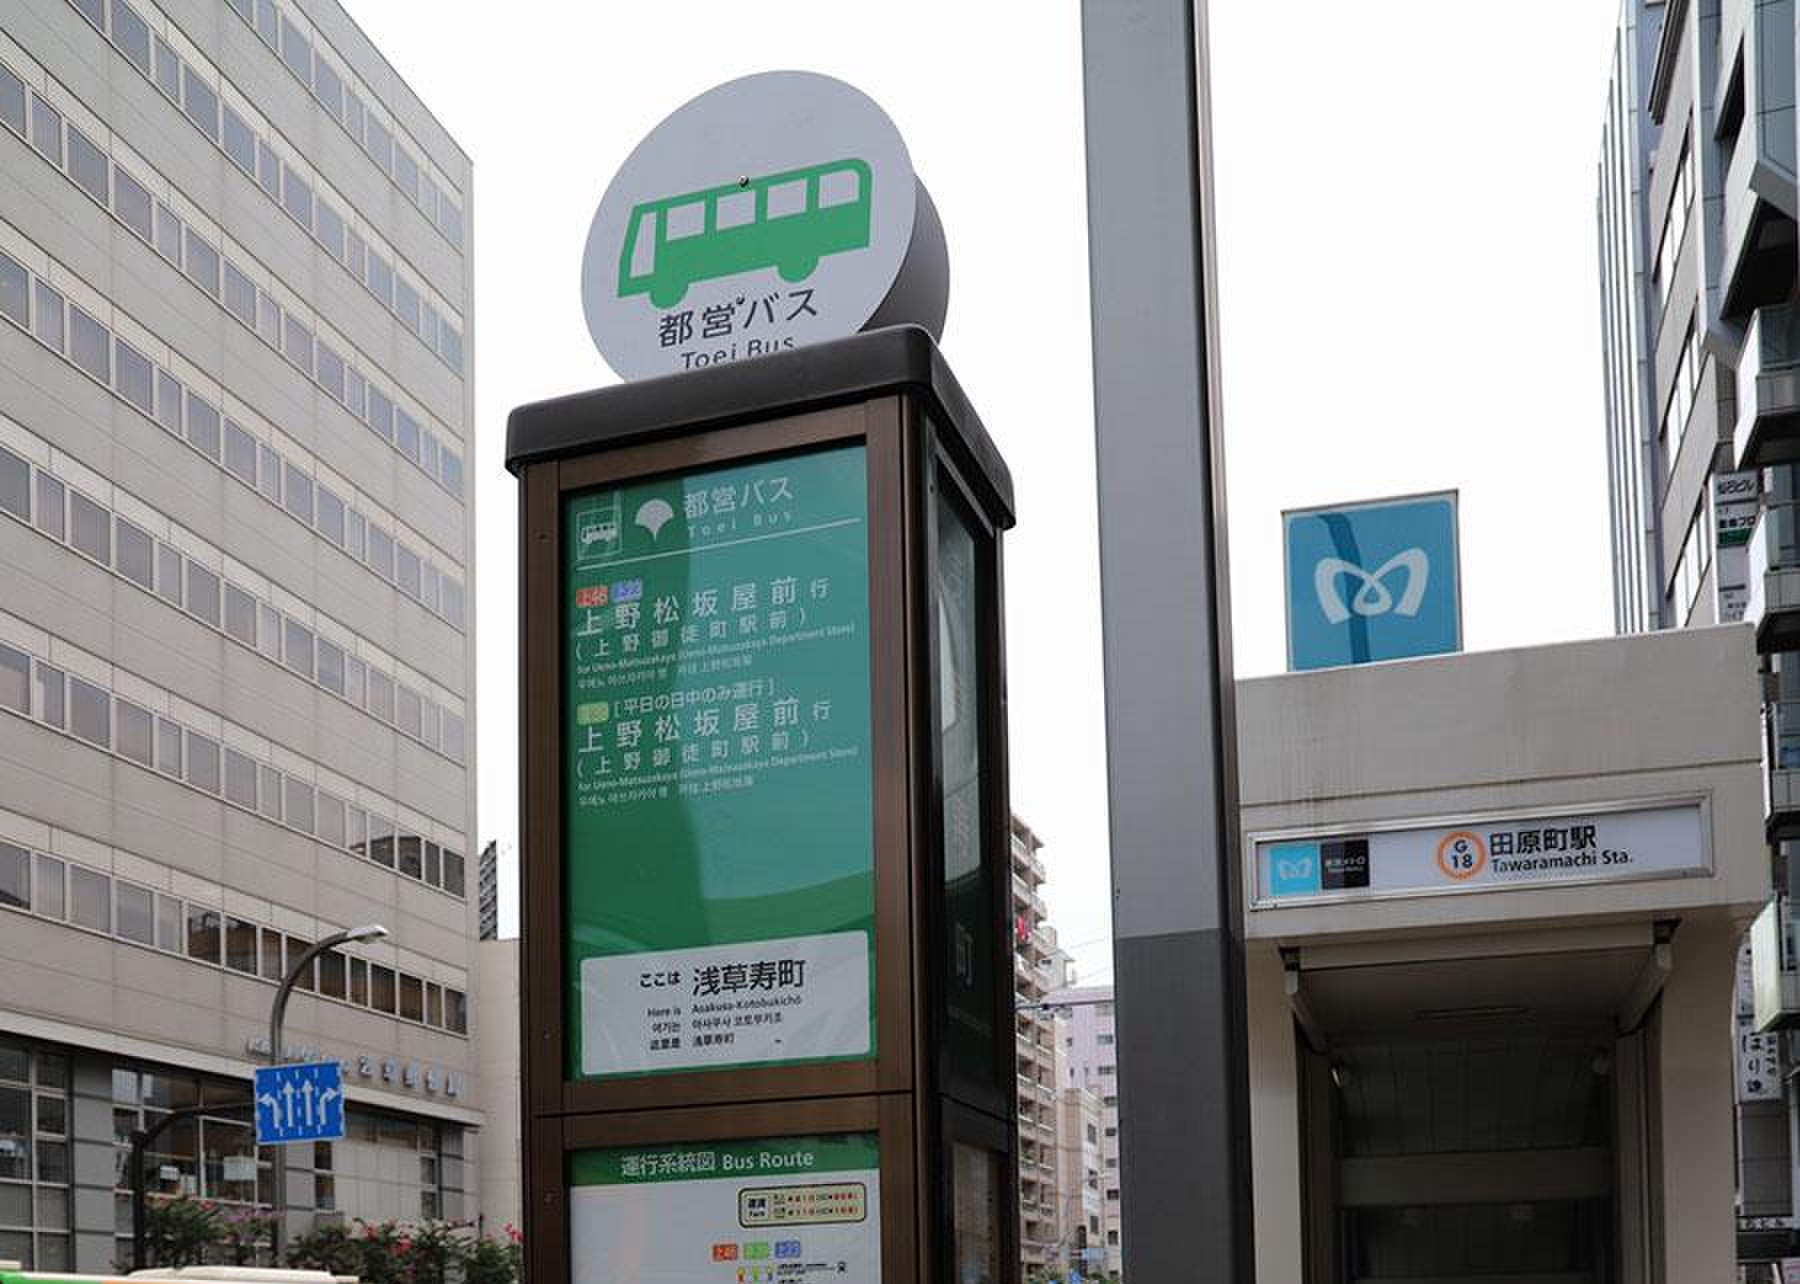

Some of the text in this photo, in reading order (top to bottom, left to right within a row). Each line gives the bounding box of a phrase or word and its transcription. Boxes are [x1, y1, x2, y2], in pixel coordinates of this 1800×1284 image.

[659, 289, 817, 348] 都営バス
[681, 343, 737, 369] Toei
[684, 477, 793, 520] 都営バス
[688, 520, 737, 538] Toei
[1454, 838, 1468, 853] G
[1489, 825, 1597, 857] 田原町駅
[1450, 853, 1473, 870] 18
[1491, 848, 1634, 873] Tawaramachi Sta.
[640, 959, 806, 997] ここは 浅草寿町
[621, 1150, 815, 1177] 運行系統図 Bus Route
